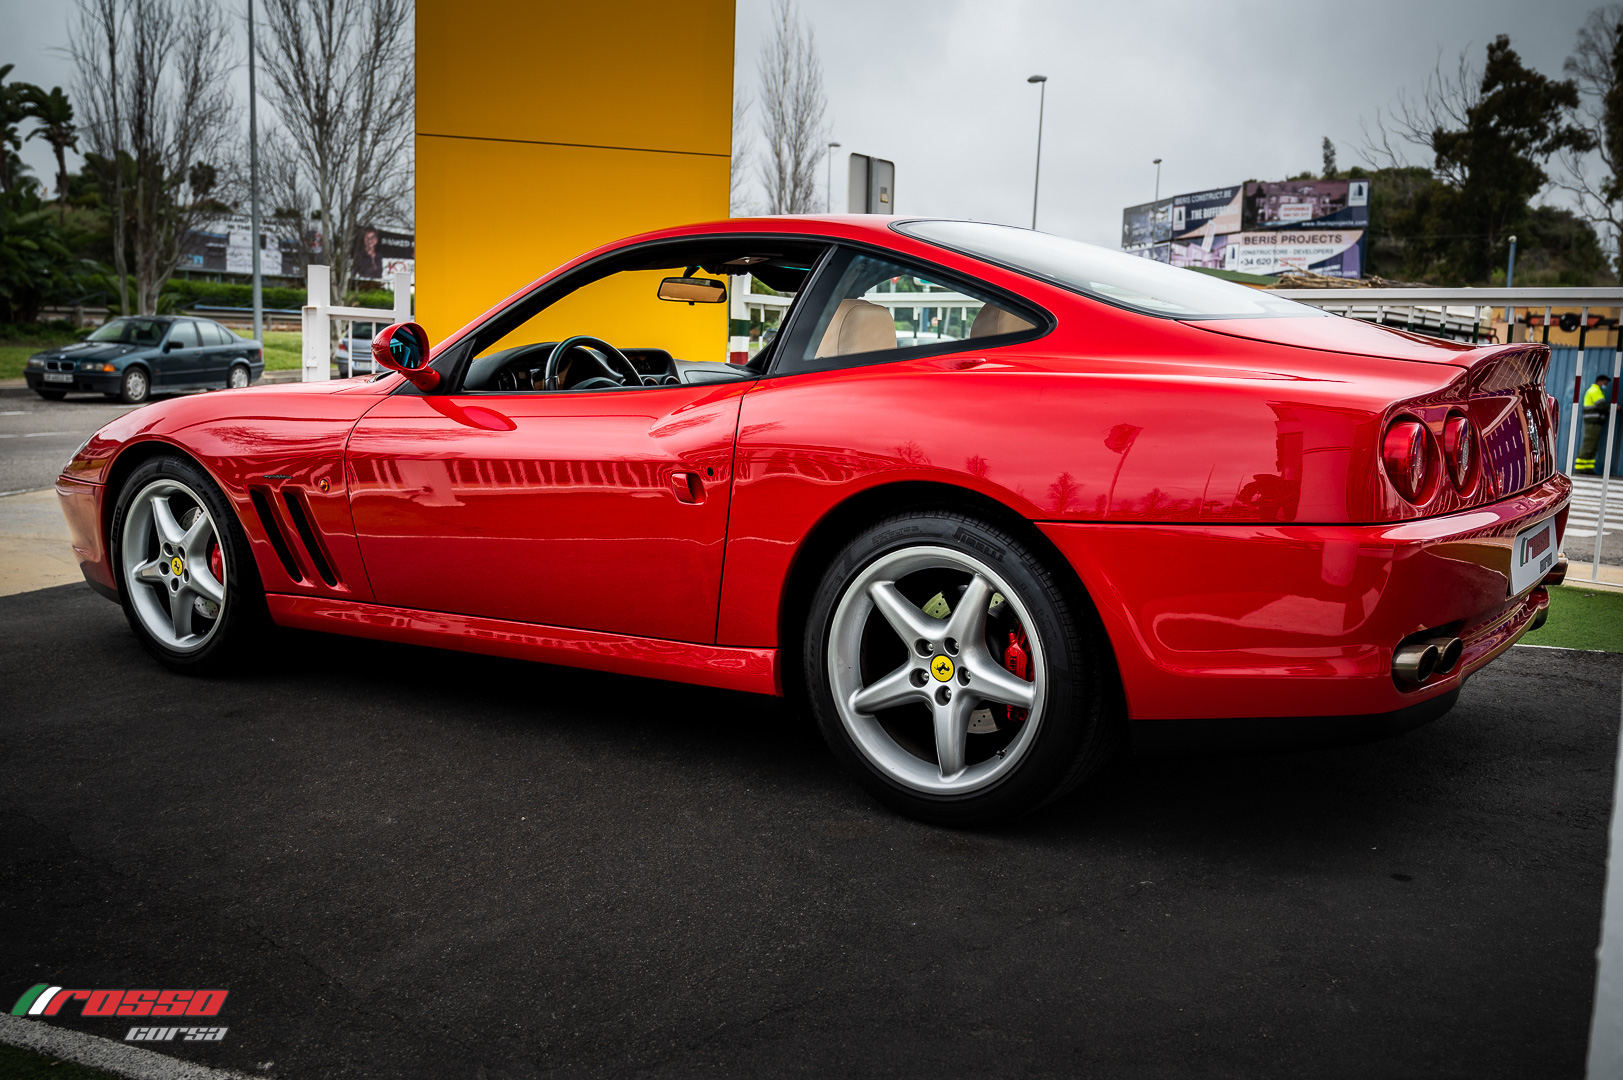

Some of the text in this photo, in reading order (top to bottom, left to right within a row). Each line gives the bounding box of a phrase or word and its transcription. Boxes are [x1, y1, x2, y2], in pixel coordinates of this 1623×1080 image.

[1281, 234, 1343, 244] PROJECTS
[1256, 257, 1272, 265] 620
[952, 526, 1006, 563] PIRELLI
